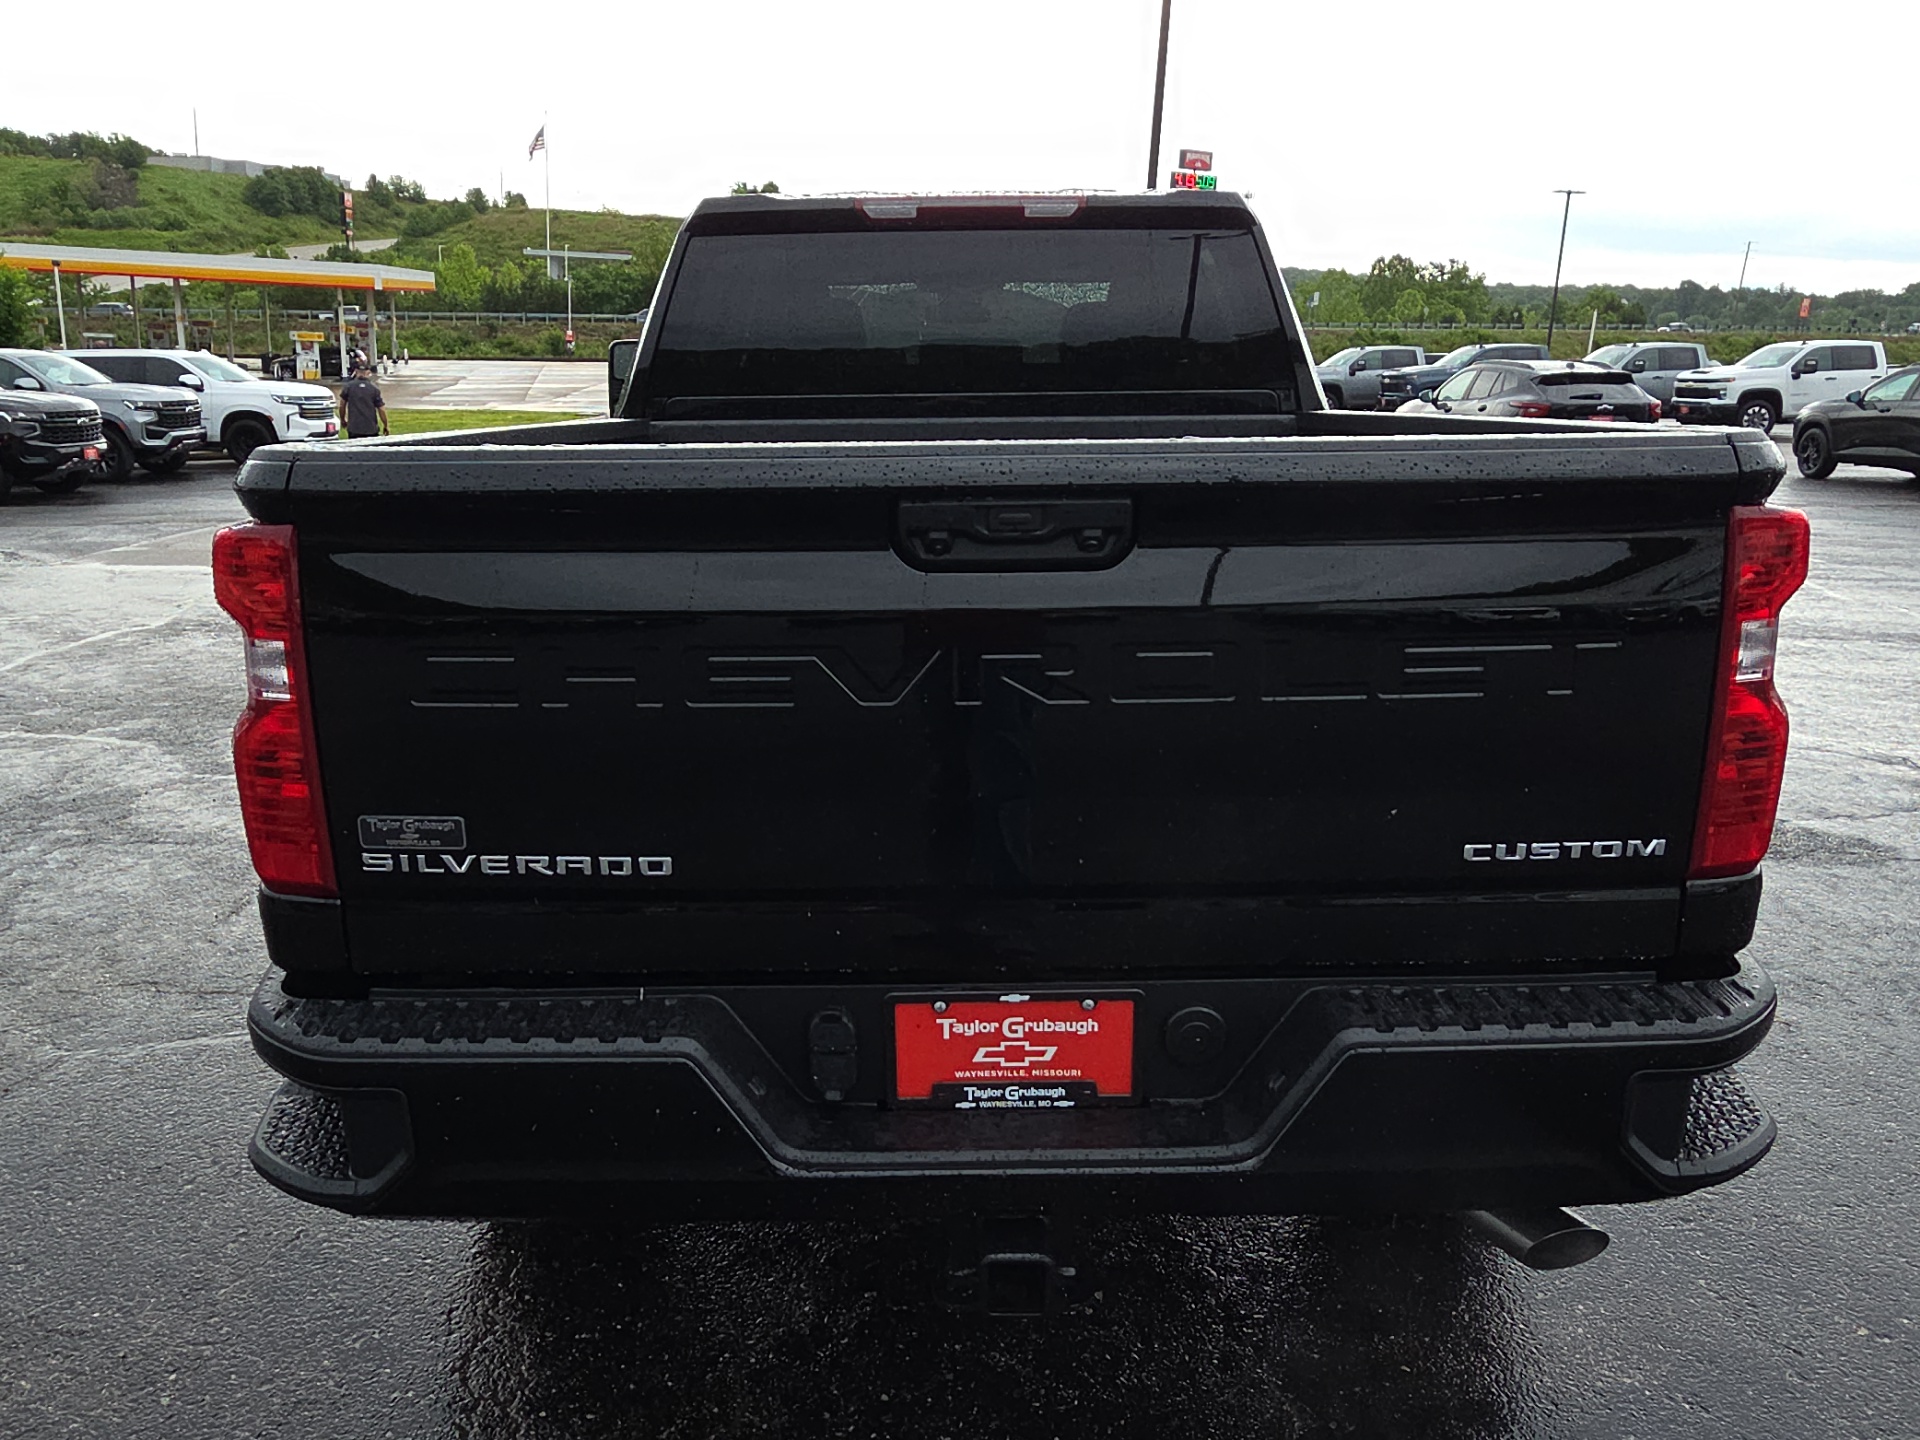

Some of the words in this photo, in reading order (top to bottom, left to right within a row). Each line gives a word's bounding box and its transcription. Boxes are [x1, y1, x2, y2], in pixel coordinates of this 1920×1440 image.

[408, 632, 1624, 710] CHEVROLET
[366, 819, 401, 832] Taylor
[402, 819, 455, 832] Grubaugh
[1463, 839, 1667, 861] CUSTOM
[361, 852, 673, 876] SILVERADO
[935, 1018, 999, 1040] Taylor
[1002, 1017, 1099, 1038] Grubaugh
[1032, 1069, 1082, 1078] MISSOURI
[963, 1086, 1004, 1101] Taylor
[1004, 1086, 1066, 1100] Grubaugh
[979, 1100, 1037, 1109] WAYNESVILLE,
[1038, 1100, 1052, 1108] MO
